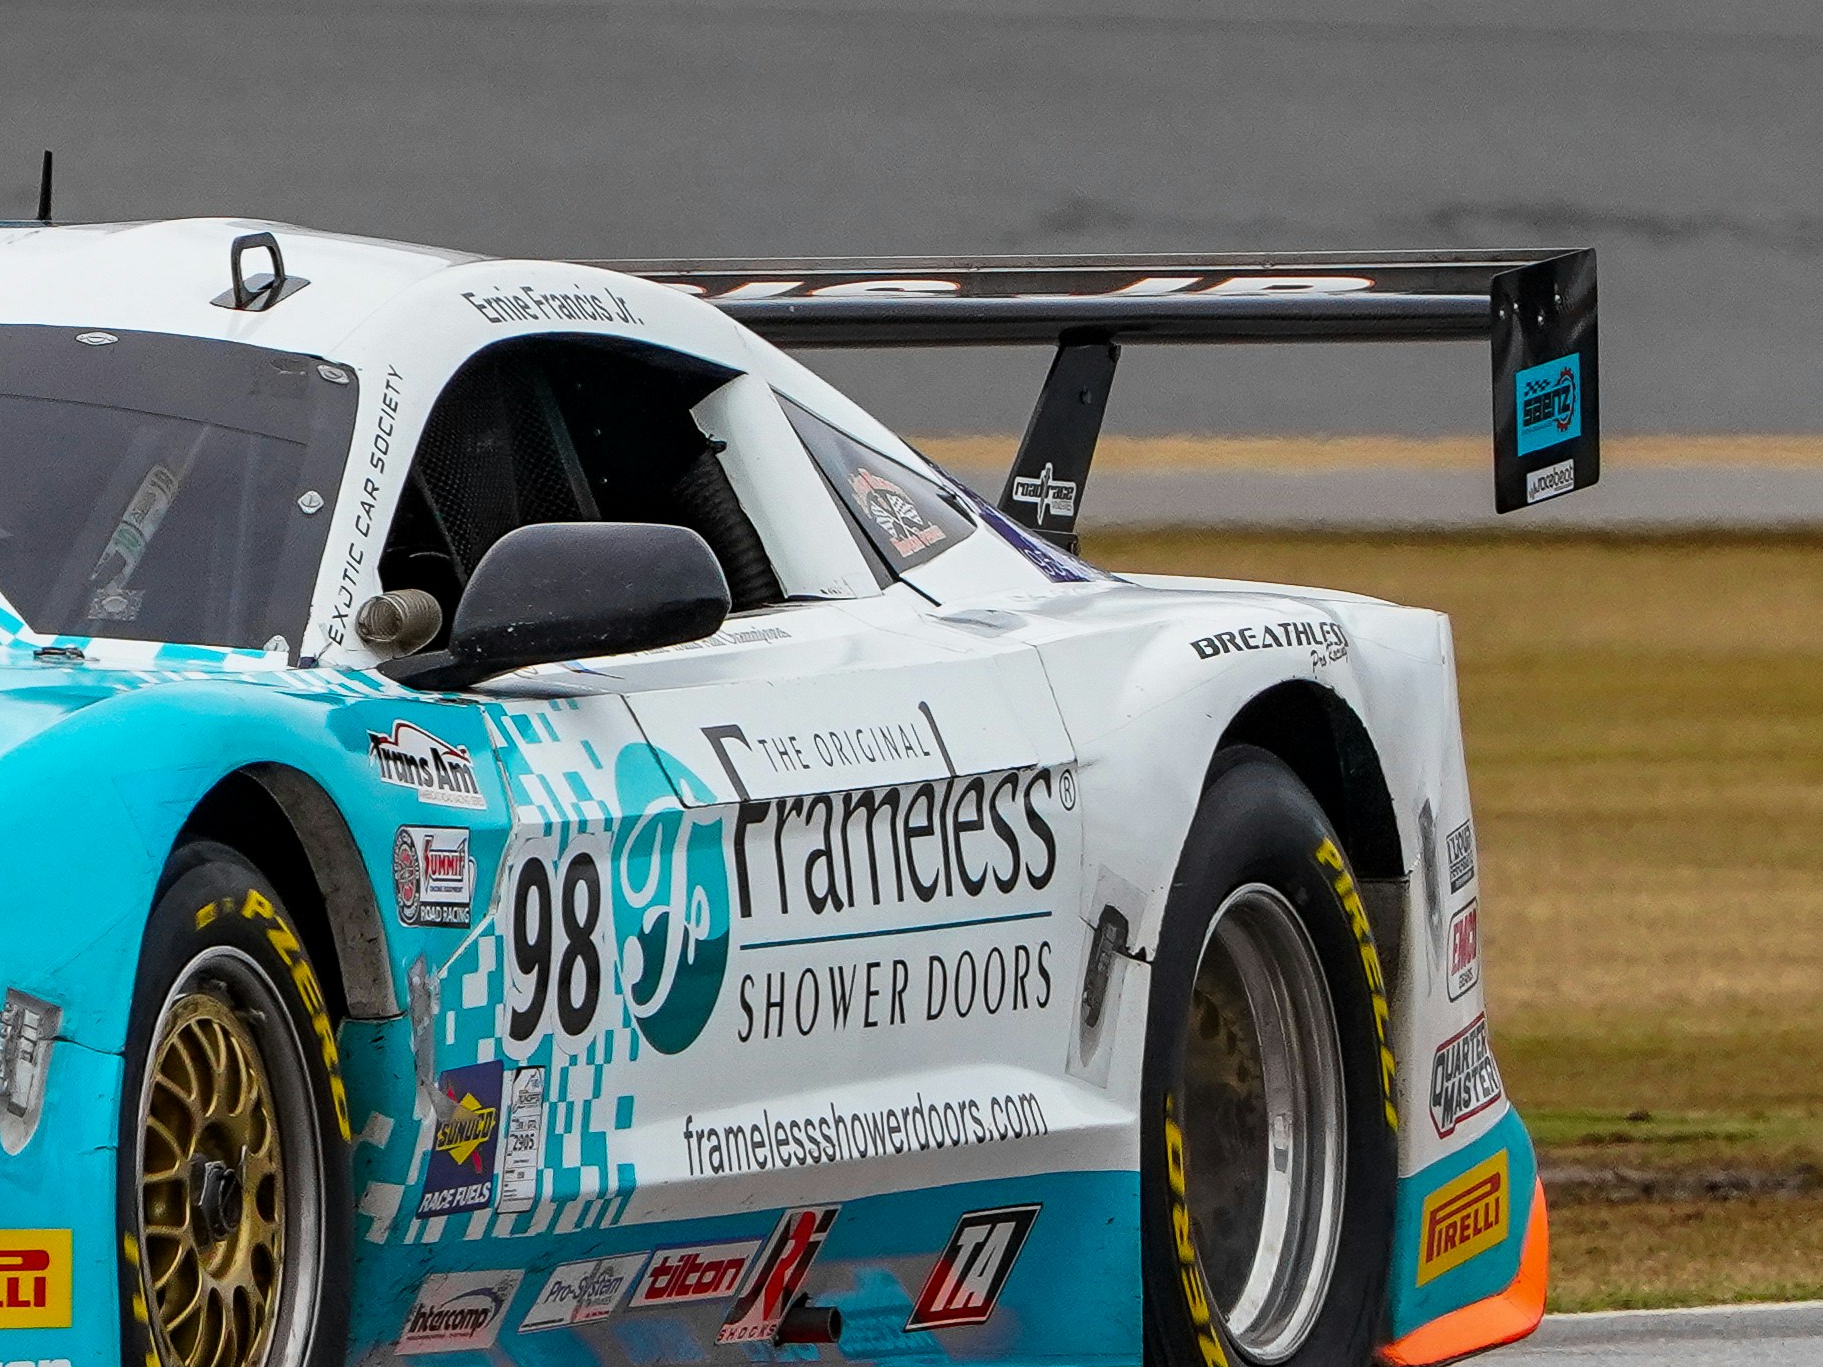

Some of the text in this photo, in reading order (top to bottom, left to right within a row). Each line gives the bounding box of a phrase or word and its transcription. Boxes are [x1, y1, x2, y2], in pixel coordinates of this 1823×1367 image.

[461, 286, 539, 324] Ernie
[520, 283, 614, 322] Francis
[604, 287, 645, 326] Jr.
[328, 364, 403, 646] EXOTIC CAR SOCIETY
[368, 733, 479, 795] Trans Am
[757, 722, 931, 774] THE ORIGINAL
[509, 851, 601, 1043] 98
[737, 940, 1052, 1043] SHOWER DOORS
[1432, 1020, 1488, 1108] QUARTER
[1441, 1055, 1499, 1130] MASTER
[683, 1091, 1050, 1177] framelessshowerdoors.com
[418, 1187, 454, 1214] RACE
[453, 1181, 492, 1208] FUELS
[1426, 1171, 1502, 1264] PIRELLI
[644, 1252, 750, 1301] tilton
[930, 1221, 1017, 1313] TA
[407, 1302, 490, 1340] Intercomp
[716, 1324, 777, 1343] SHOCKS
